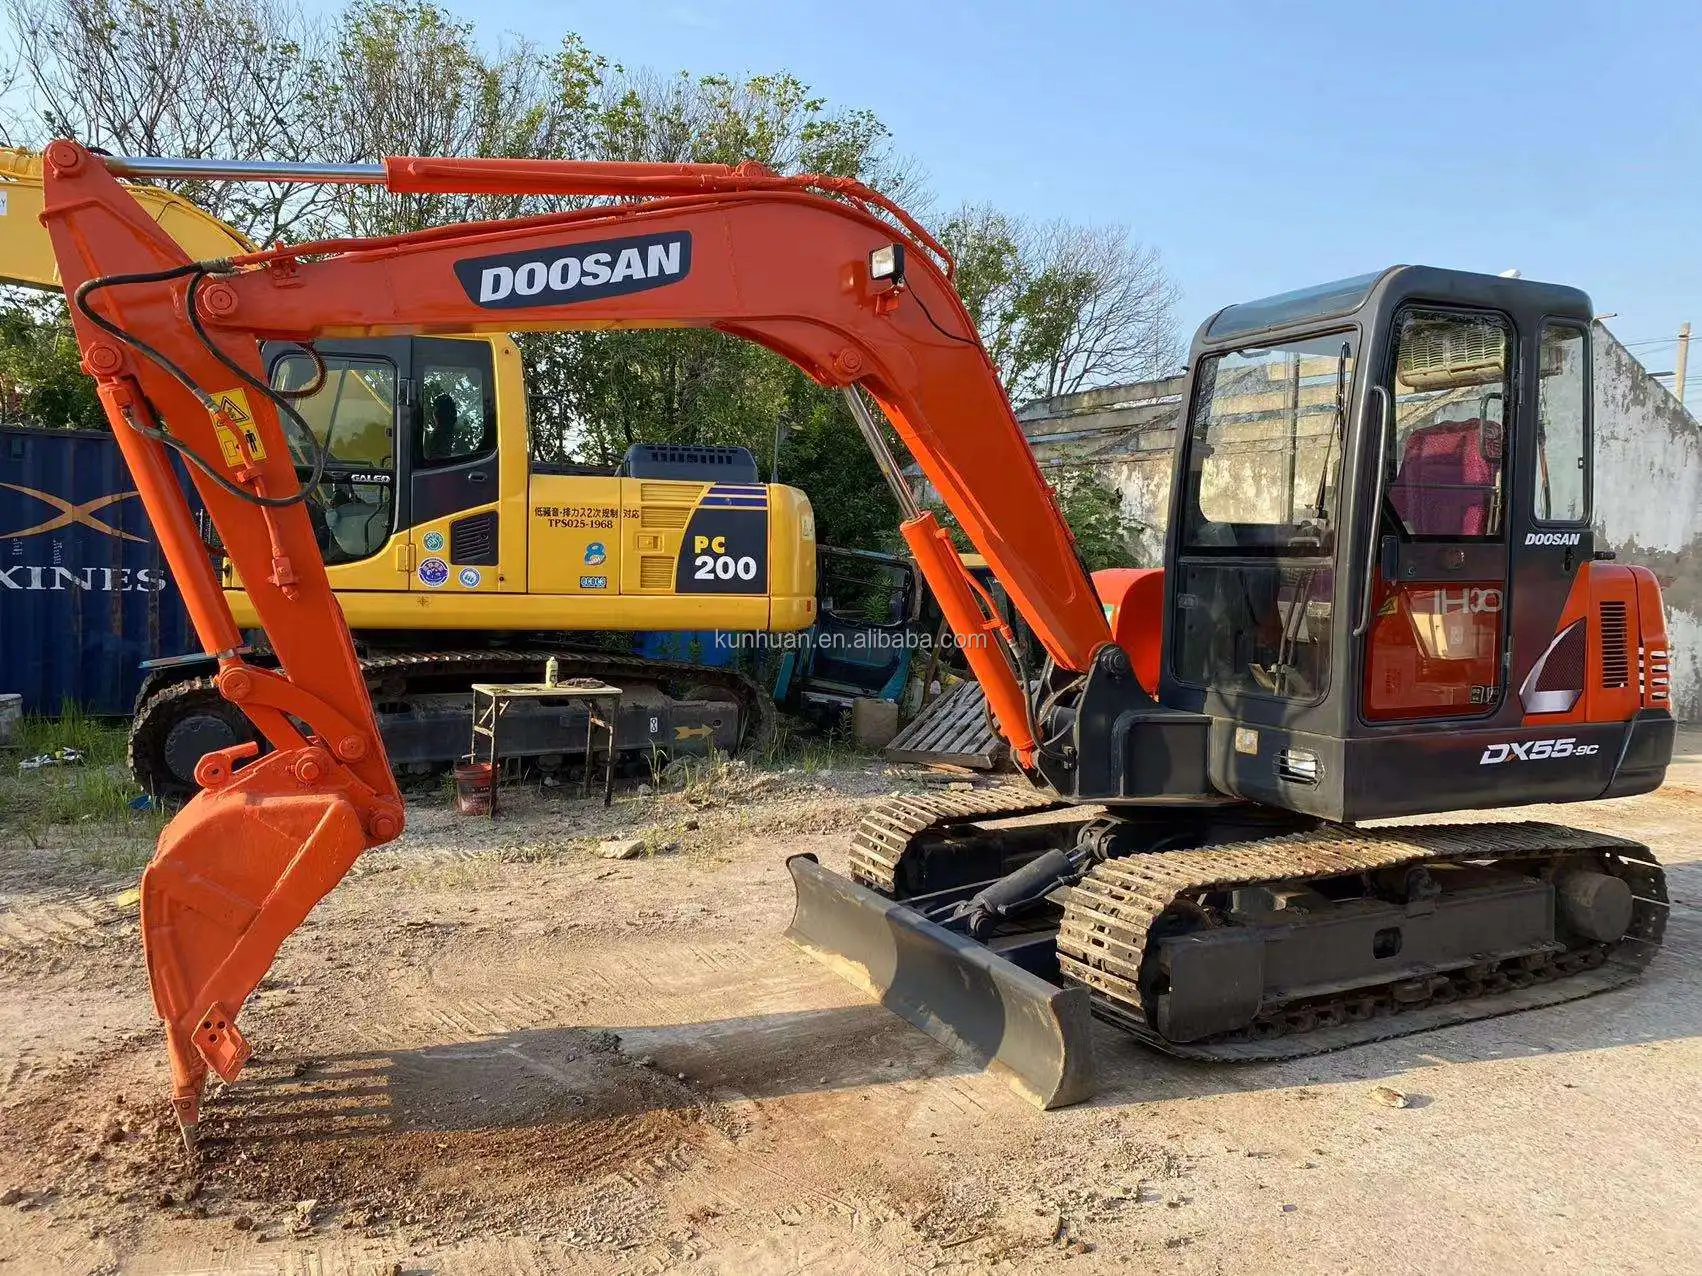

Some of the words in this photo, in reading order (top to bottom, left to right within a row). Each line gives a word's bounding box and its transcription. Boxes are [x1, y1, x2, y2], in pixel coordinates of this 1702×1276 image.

[480, 242, 681, 302] DOOSAN
[351, 474, 391, 482] GALEO
[548, 519, 614, 529] TPS025-1968
[694, 535, 726, 554] PC
[1525, 533, 1581, 545] DOOSAN
[694, 555, 757, 580] 200
[1480, 738, 1600, 765] DX55-9C
